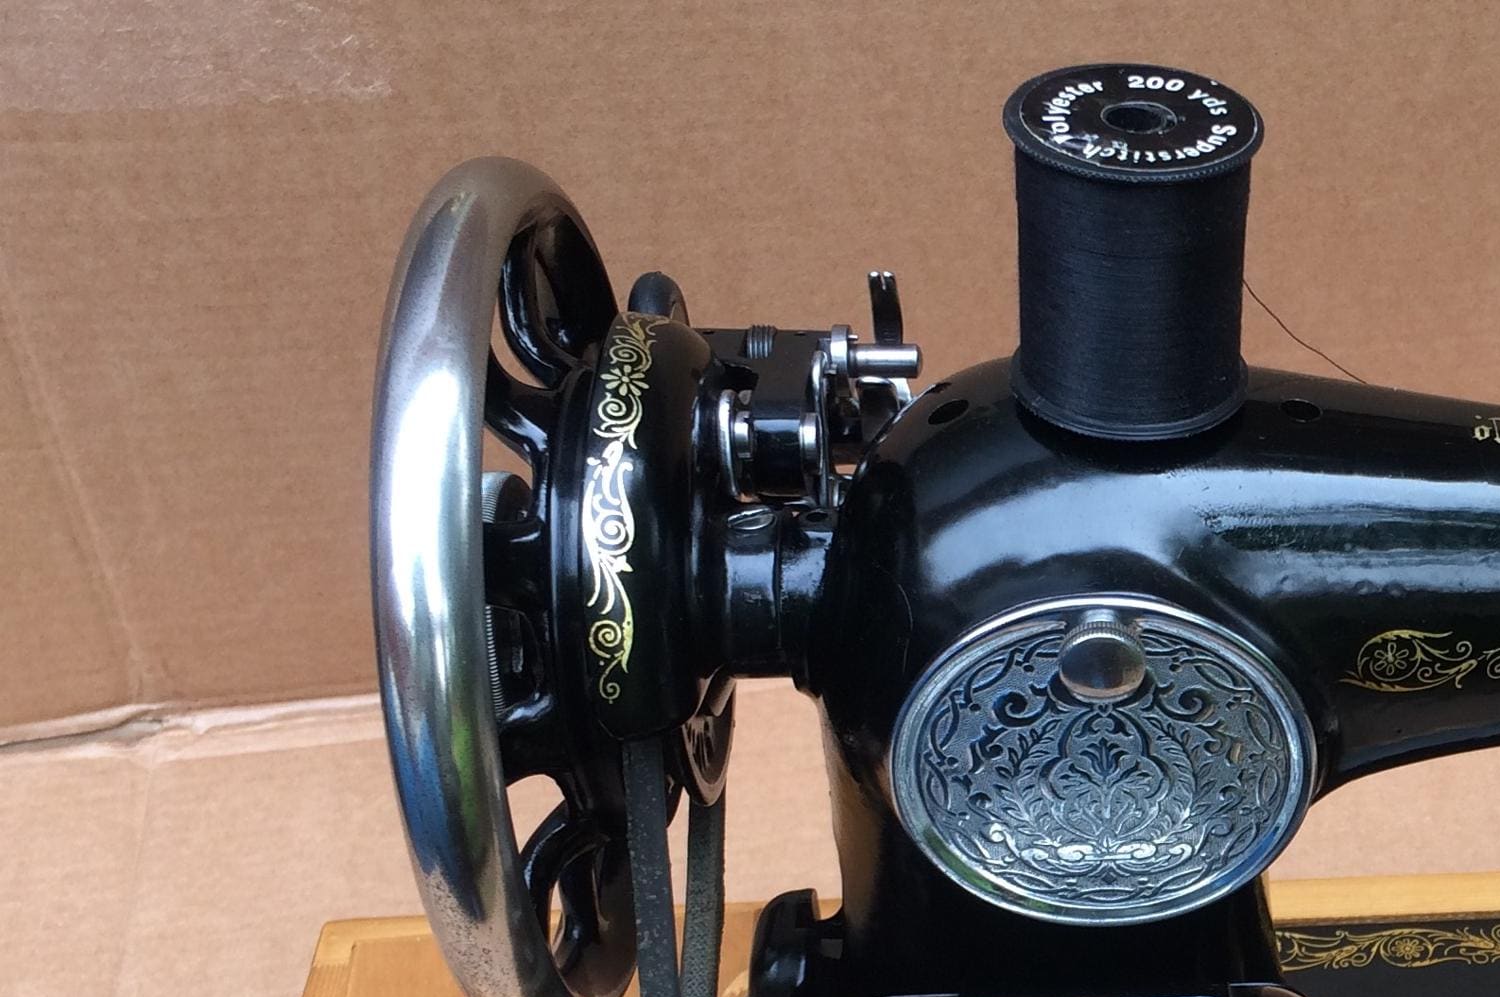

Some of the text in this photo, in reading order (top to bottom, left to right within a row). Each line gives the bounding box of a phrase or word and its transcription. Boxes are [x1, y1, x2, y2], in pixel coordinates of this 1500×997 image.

[1127, 75, 1186, 92] 200
[1187, 88, 1228, 116] yds
[1081, 124, 1238, 163] Superstitch
